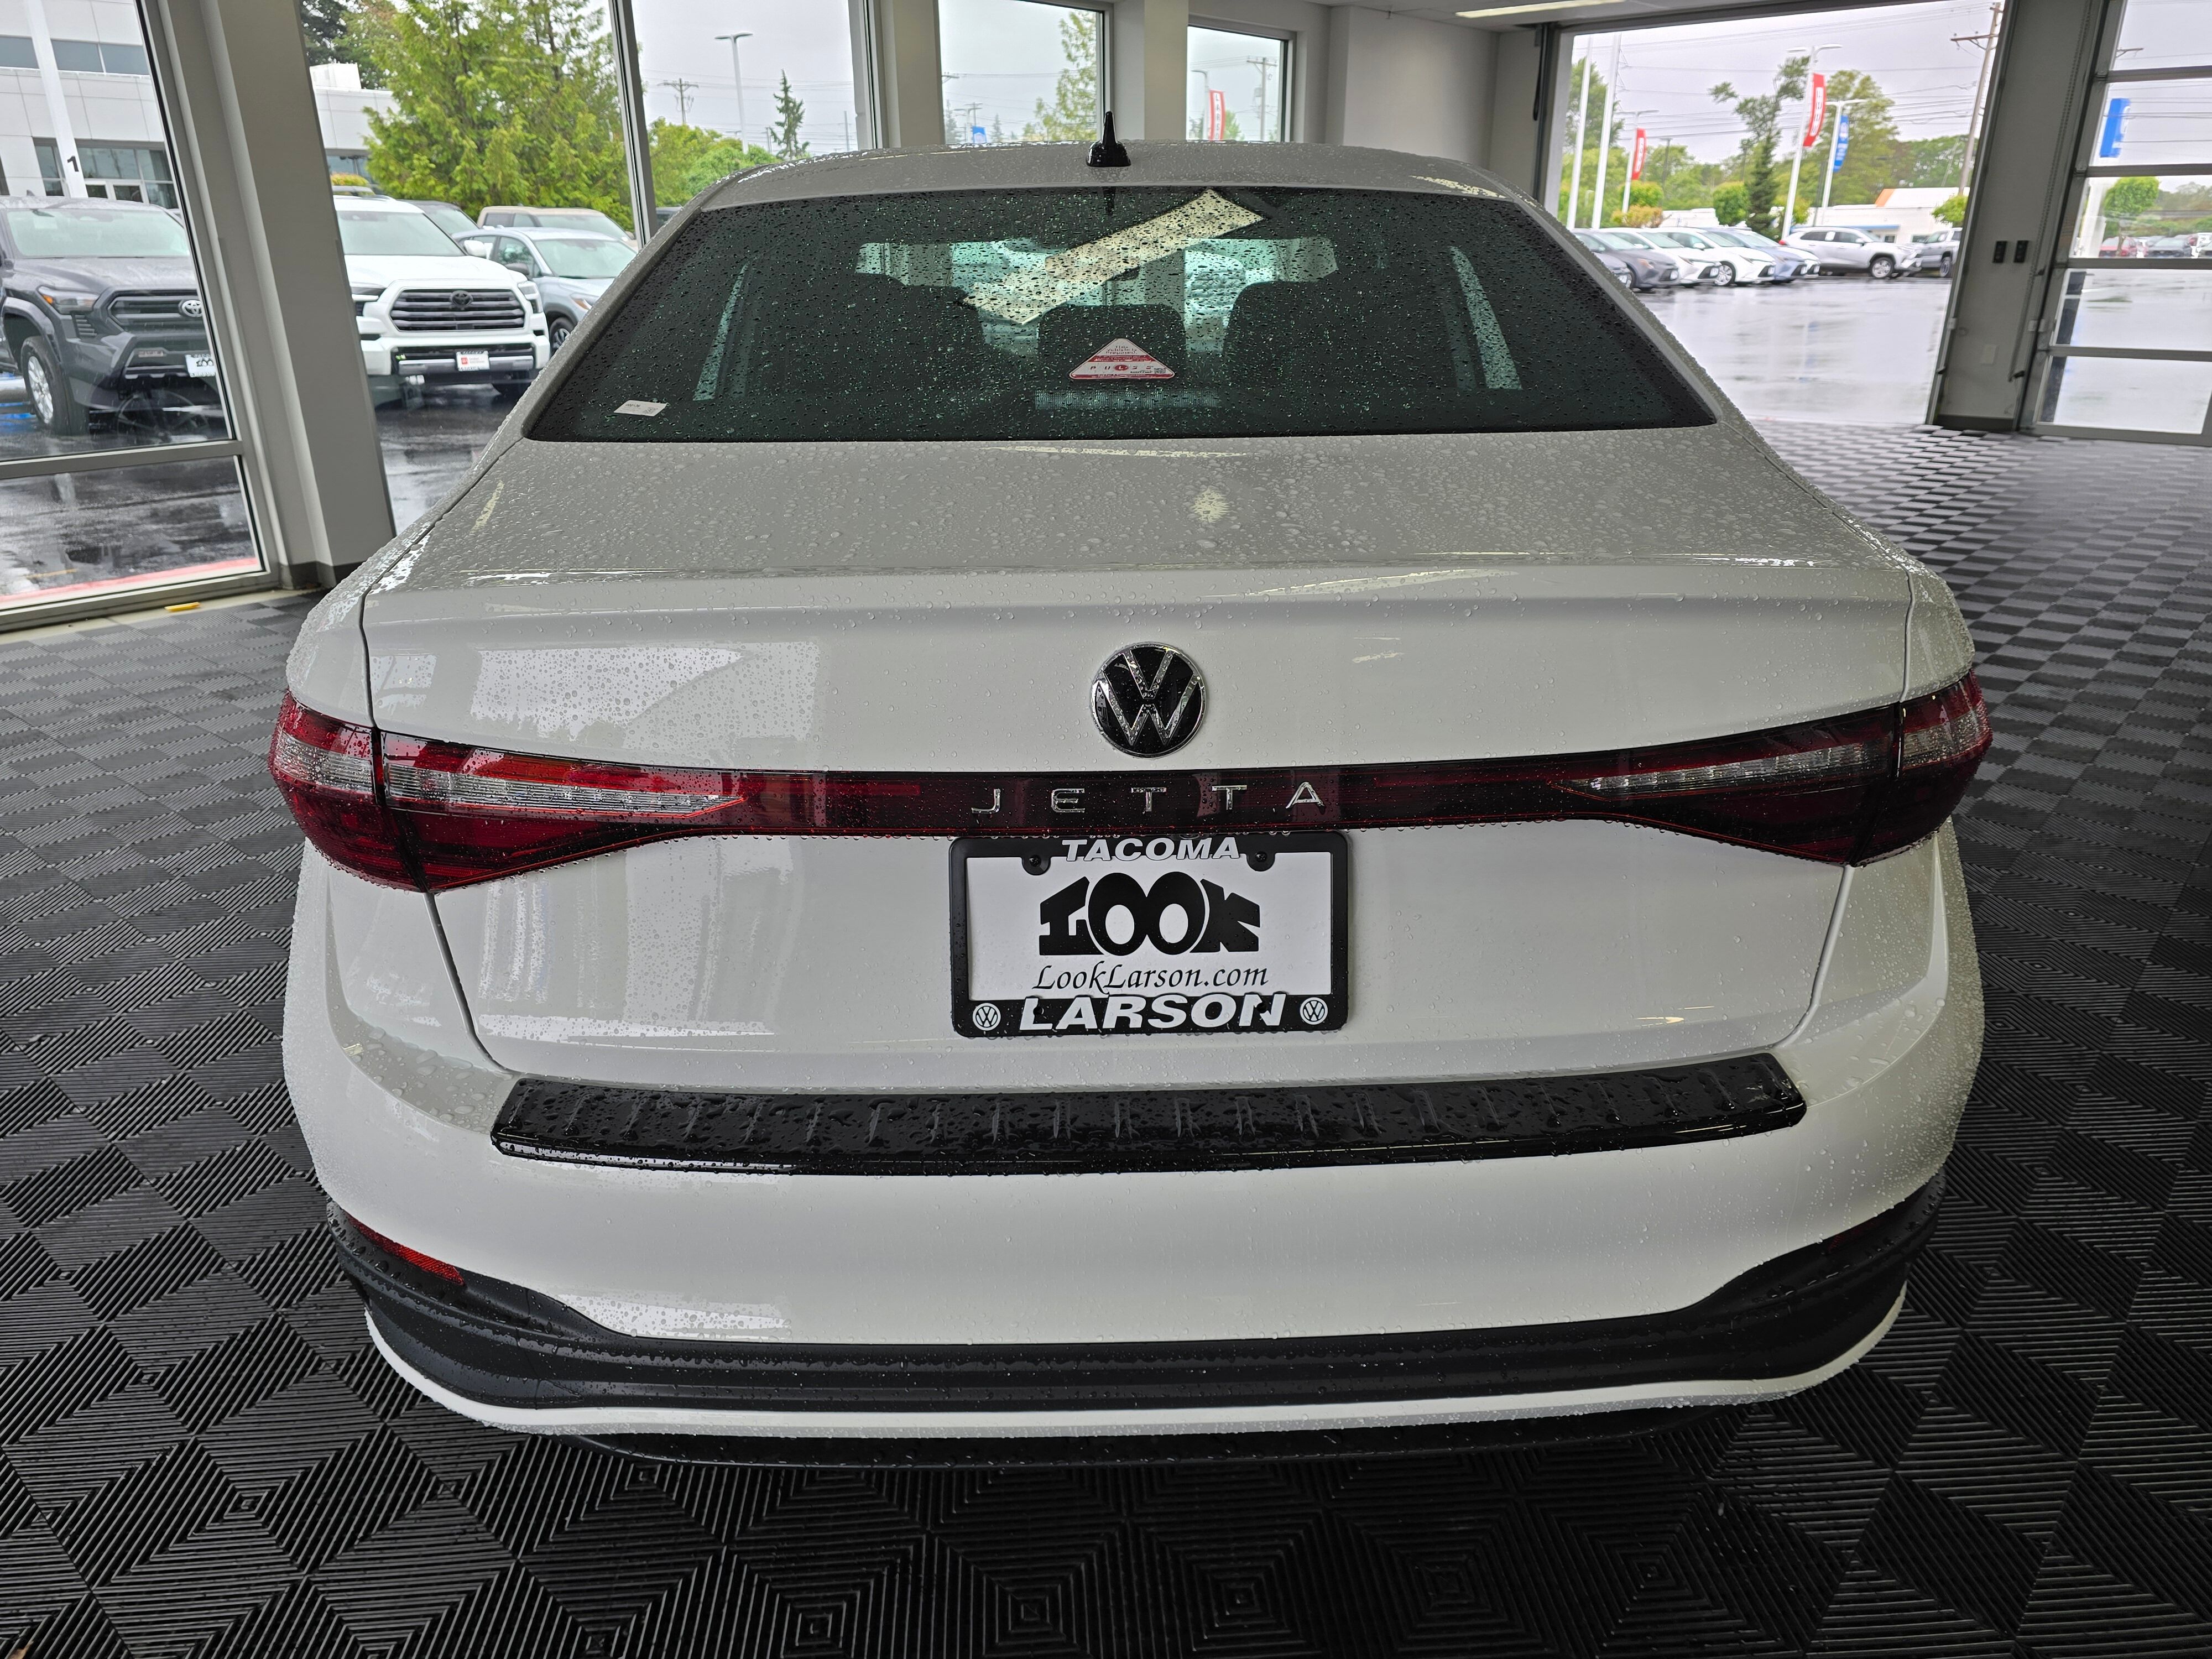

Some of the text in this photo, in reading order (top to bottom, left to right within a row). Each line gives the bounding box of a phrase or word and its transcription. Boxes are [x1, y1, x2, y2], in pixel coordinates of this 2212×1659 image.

[67, 156, 79, 172] 1
[971, 781, 1325, 813] JETTA
[1061, 837, 1240, 862] TACOMA
[1039, 872, 1261, 956] LOOK
[1031, 961, 1269, 995] LookLarson.com
[1019, 993, 1287, 1031] LARSON
